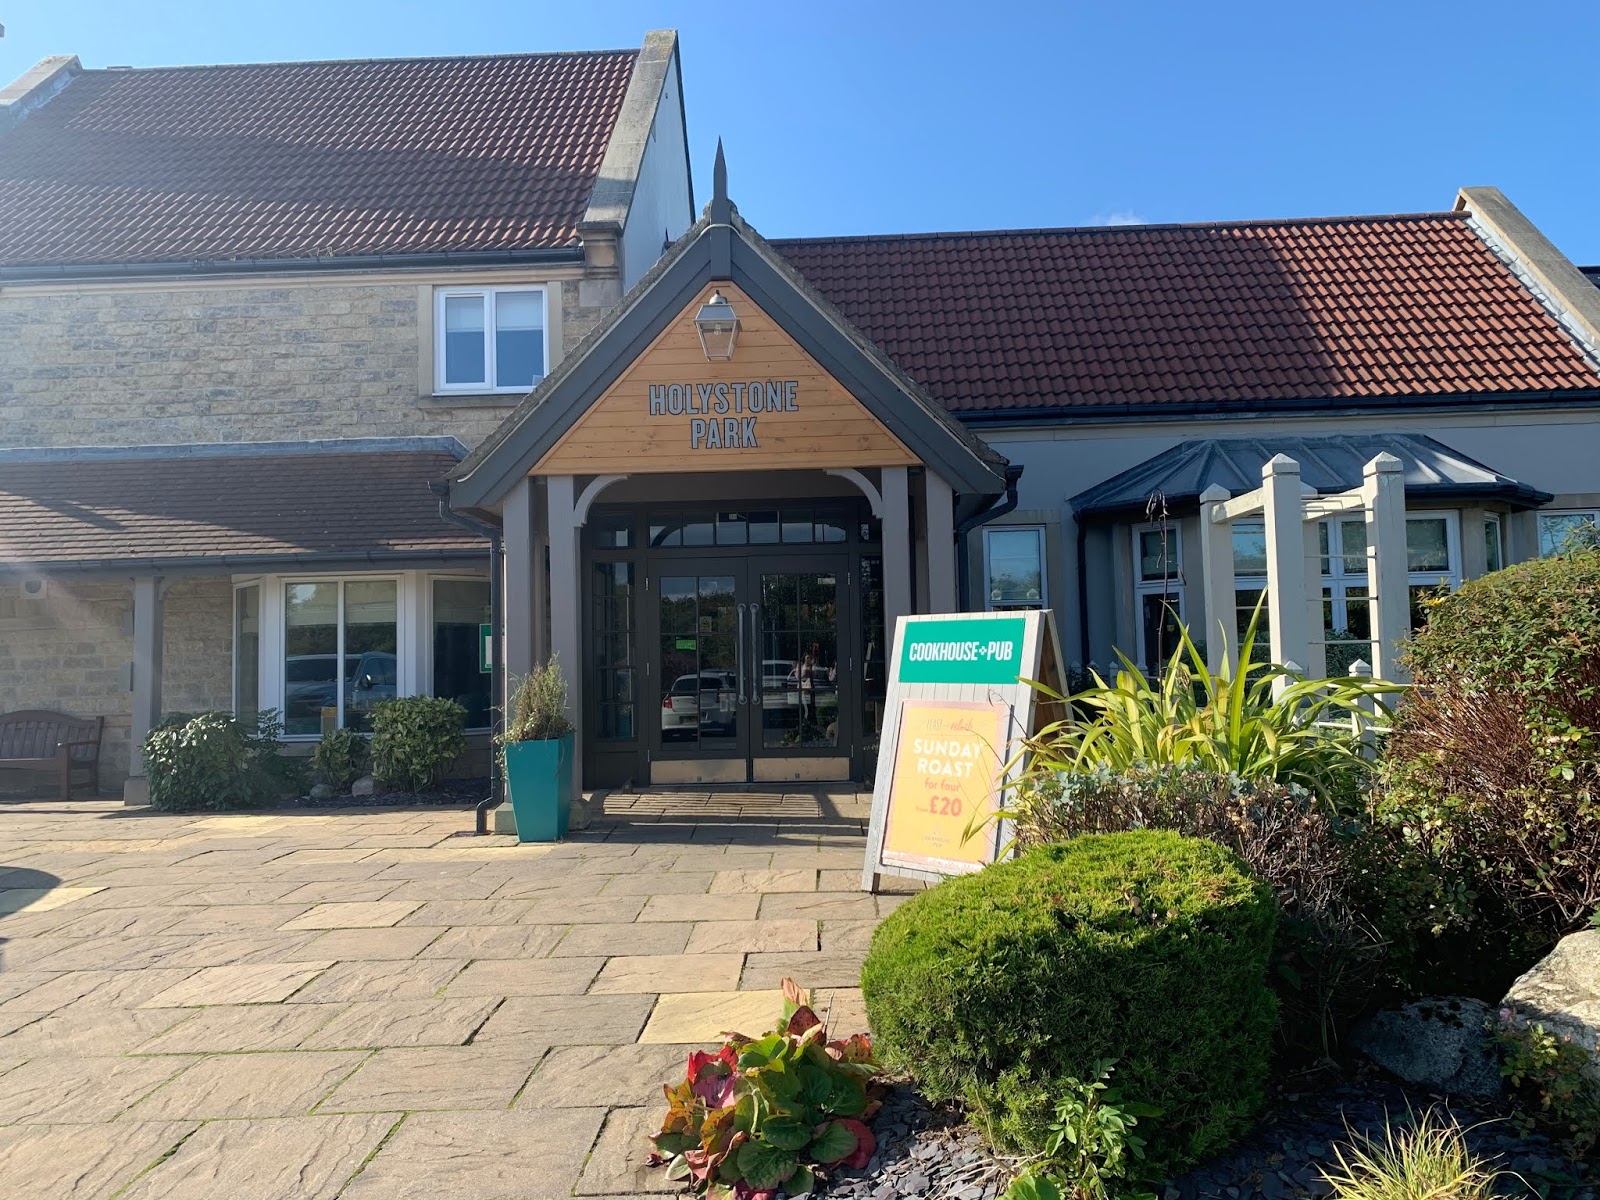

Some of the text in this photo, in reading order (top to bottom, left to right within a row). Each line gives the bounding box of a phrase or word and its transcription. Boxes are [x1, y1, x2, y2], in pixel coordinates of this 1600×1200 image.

[649, 380, 799, 416] HOLYSTONE
[690, 416, 758, 449] PARK
[912, 738, 984, 760] SUNDAY
[917, 757, 974, 778] ROAST
[924, 777, 960, 792] for four
[929, 795, 963, 817] £20
